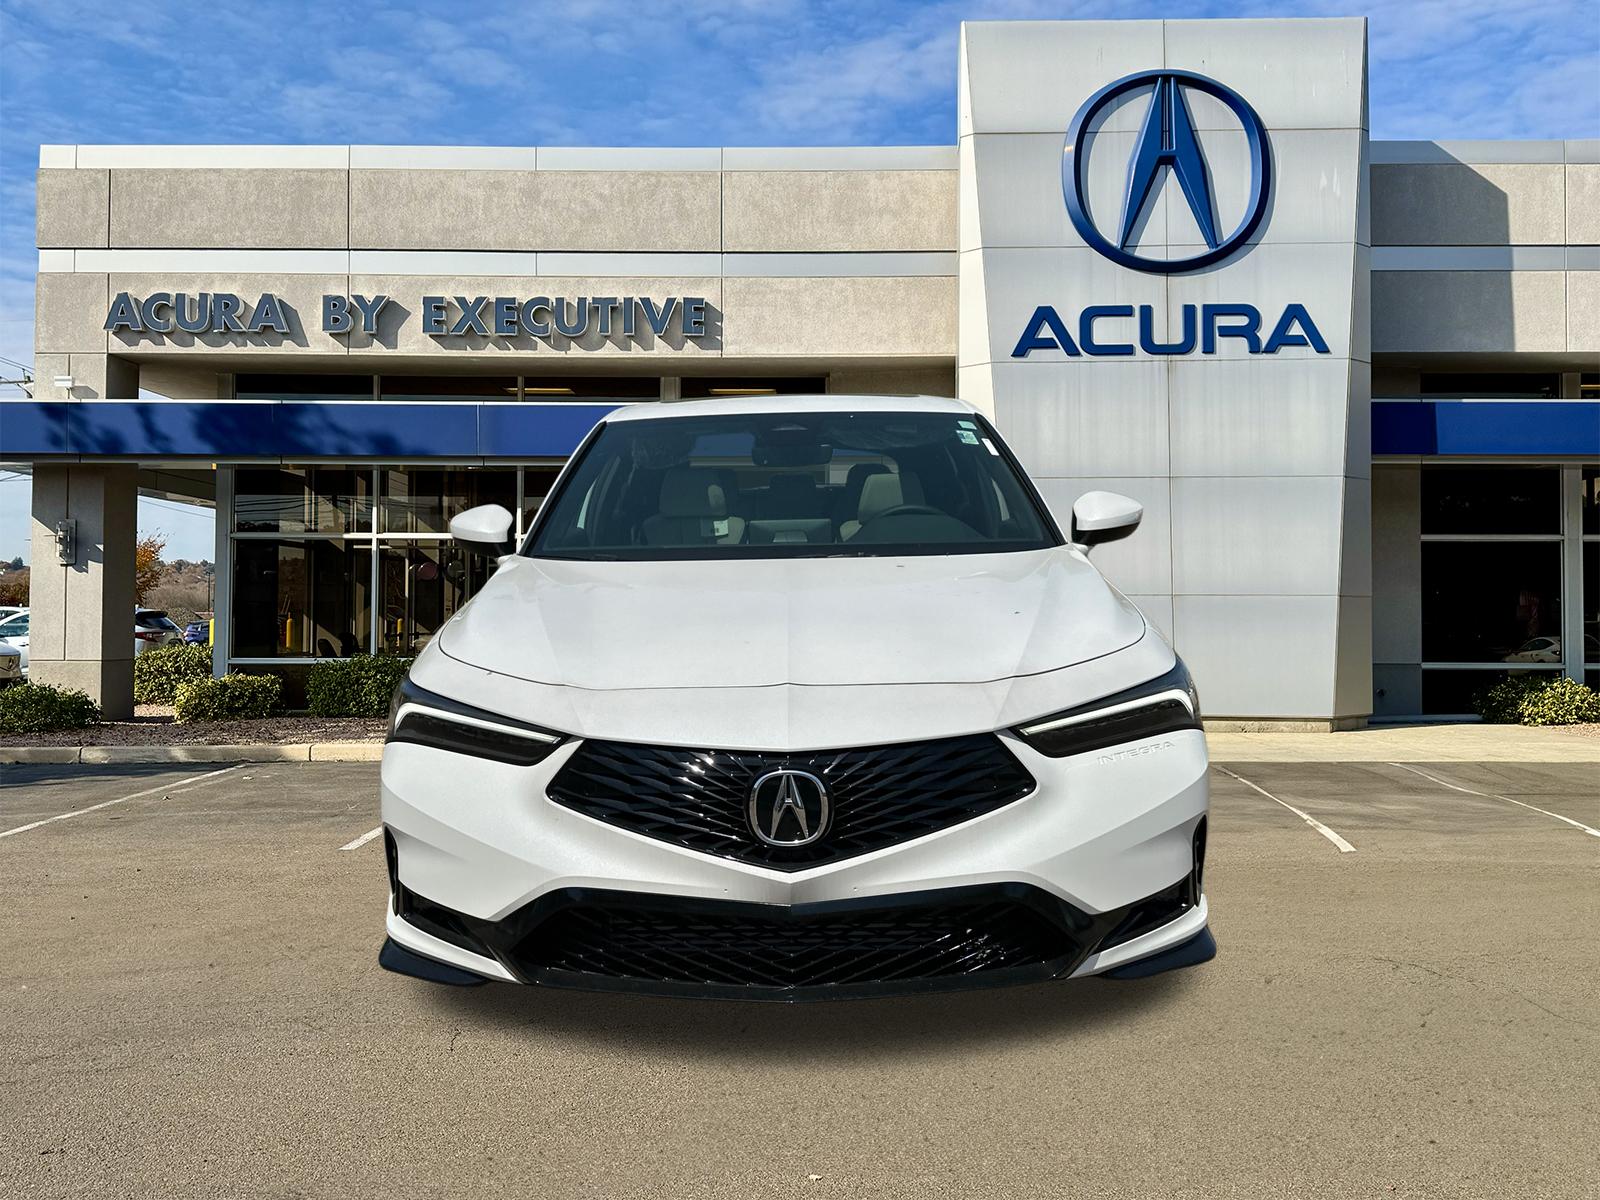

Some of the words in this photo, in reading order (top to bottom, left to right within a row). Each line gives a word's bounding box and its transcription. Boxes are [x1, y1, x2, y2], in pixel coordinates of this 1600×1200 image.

[104, 291, 289, 334] ACURA
[322, 294, 390, 335] BY
[422, 295, 707, 337] EXECUTIVE
[1011, 303, 1332, 357] ACURA
[1097, 740, 1176, 766] INTEGRA
